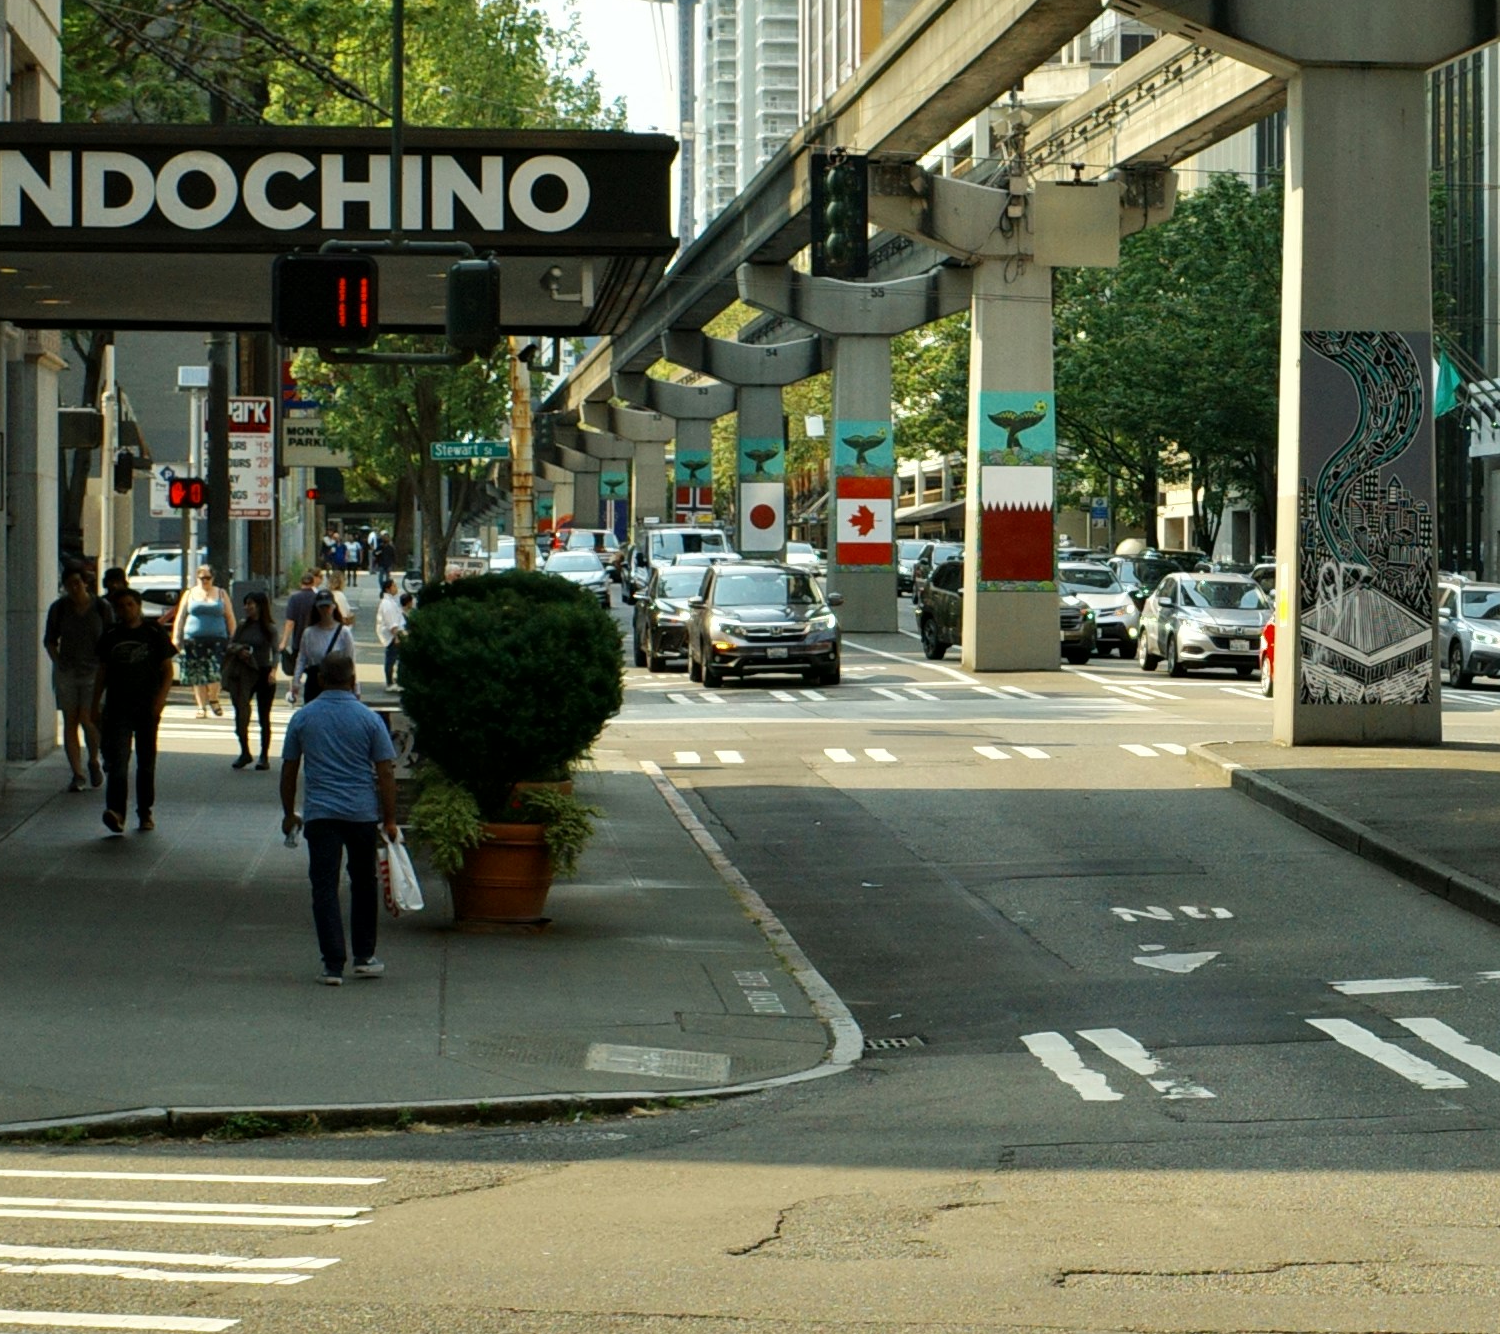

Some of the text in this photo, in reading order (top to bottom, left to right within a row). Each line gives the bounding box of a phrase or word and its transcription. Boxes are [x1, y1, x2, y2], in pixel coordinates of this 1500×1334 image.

[871, 287, 885, 298] 55
[765, 348, 778, 357] 54
[435, 443, 479, 457] Stewart
